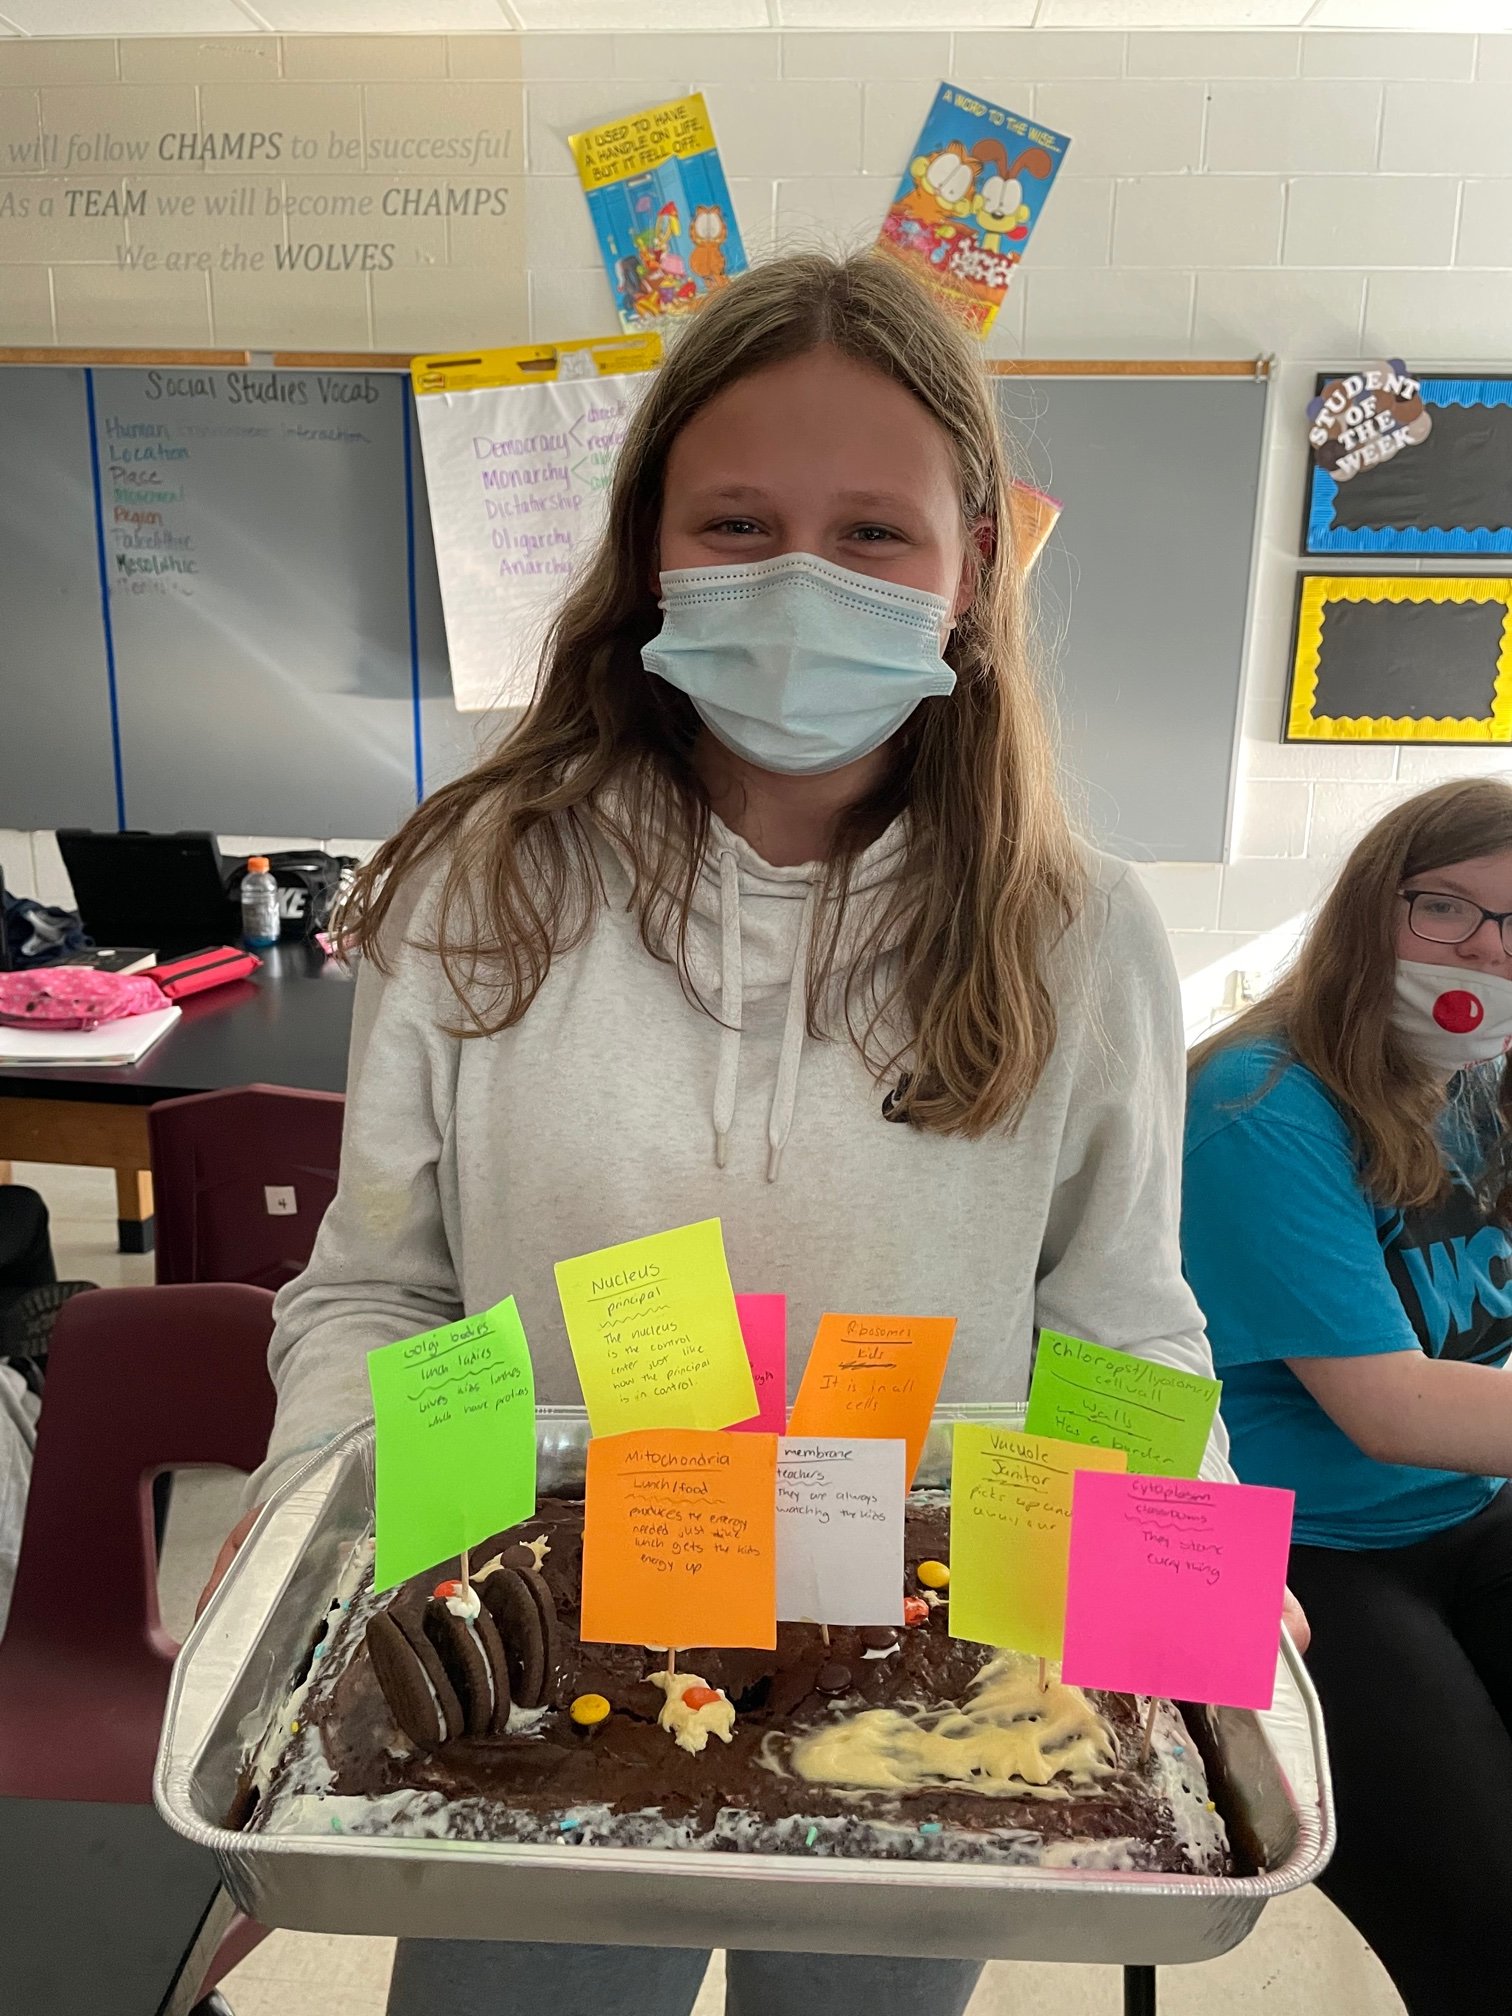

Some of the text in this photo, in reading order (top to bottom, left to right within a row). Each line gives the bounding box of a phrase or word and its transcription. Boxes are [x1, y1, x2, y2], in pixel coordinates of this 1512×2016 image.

[584, 106, 687, 150] I USED TO HAVE
[989, 109, 1005, 126] TO
[1006, 117, 1028, 136] THE
[8, 129, 512, 169] will follow CHAMPS to be successful
[585, 155, 594, 167] A
[599, 135, 649, 160] HANDLE
[650, 127, 669, 144] ON
[592, 164, 620, 181] BUT
[623, 156, 636, 170] IT
[639, 145, 671, 164] FELL
[0, 187, 508, 217] As a TEAM we will become CHAMPS
[115, 243, 395, 271] We are the WOLVES
[145, 371, 379, 405] Social Studies Vocab
[1309, 371, 1421, 446] STUDENT
[1345, 395, 1377, 426] OF
[105, 417, 171, 440] Human
[1338, 410, 1395, 450] THE
[109, 443, 190, 462] Location
[473, 434, 569, 460] Democracy
[1336, 425, 1416, 474] WEEK
[109, 465, 163, 485] Place
[481, 463, 570, 491] Monarchy
[492, 528, 573, 557] Oligarchy
[499, 557, 573, 577] Anarchy
[278, 1198, 287, 1209] 4
[591, 1263, 660, 1295] Nucleus
[607, 1286, 661, 1317] principal
[450, 1321, 489, 1342] bodies
[604, 1320, 678, 1344] The nucleus
[847, 1320, 912, 1337] Ribosomes
[607, 1334, 690, 1359] is the control
[421, 1347, 492, 1381] lunch ladies
[611, 1360, 638, 1375] center
[649, 1354, 669, 1371] just
[614, 1358, 710, 1390] how the principal
[820, 1374, 914, 1392] It is in all
[619, 1392, 630, 1403] is
[634, 1391, 647, 1401] in
[846, 1396, 878, 1411] cells
[1056, 1415, 1080, 1437] Has
[1089, 1434, 1100, 1445] a
[625, 1450, 731, 1468] Mitochondria
[785, 1446, 852, 1459] membrane
[777, 1468, 825, 1481] teachers
[778, 1488, 800, 1501] They
[836, 1491, 878, 1505] always
[633, 1522, 669, 1536] needed
[709, 1513, 748, 1533] energy
[672, 1540, 705, 1555] gets
[1142, 1531, 1169, 1548] They
[685, 1561, 703, 1576] up
